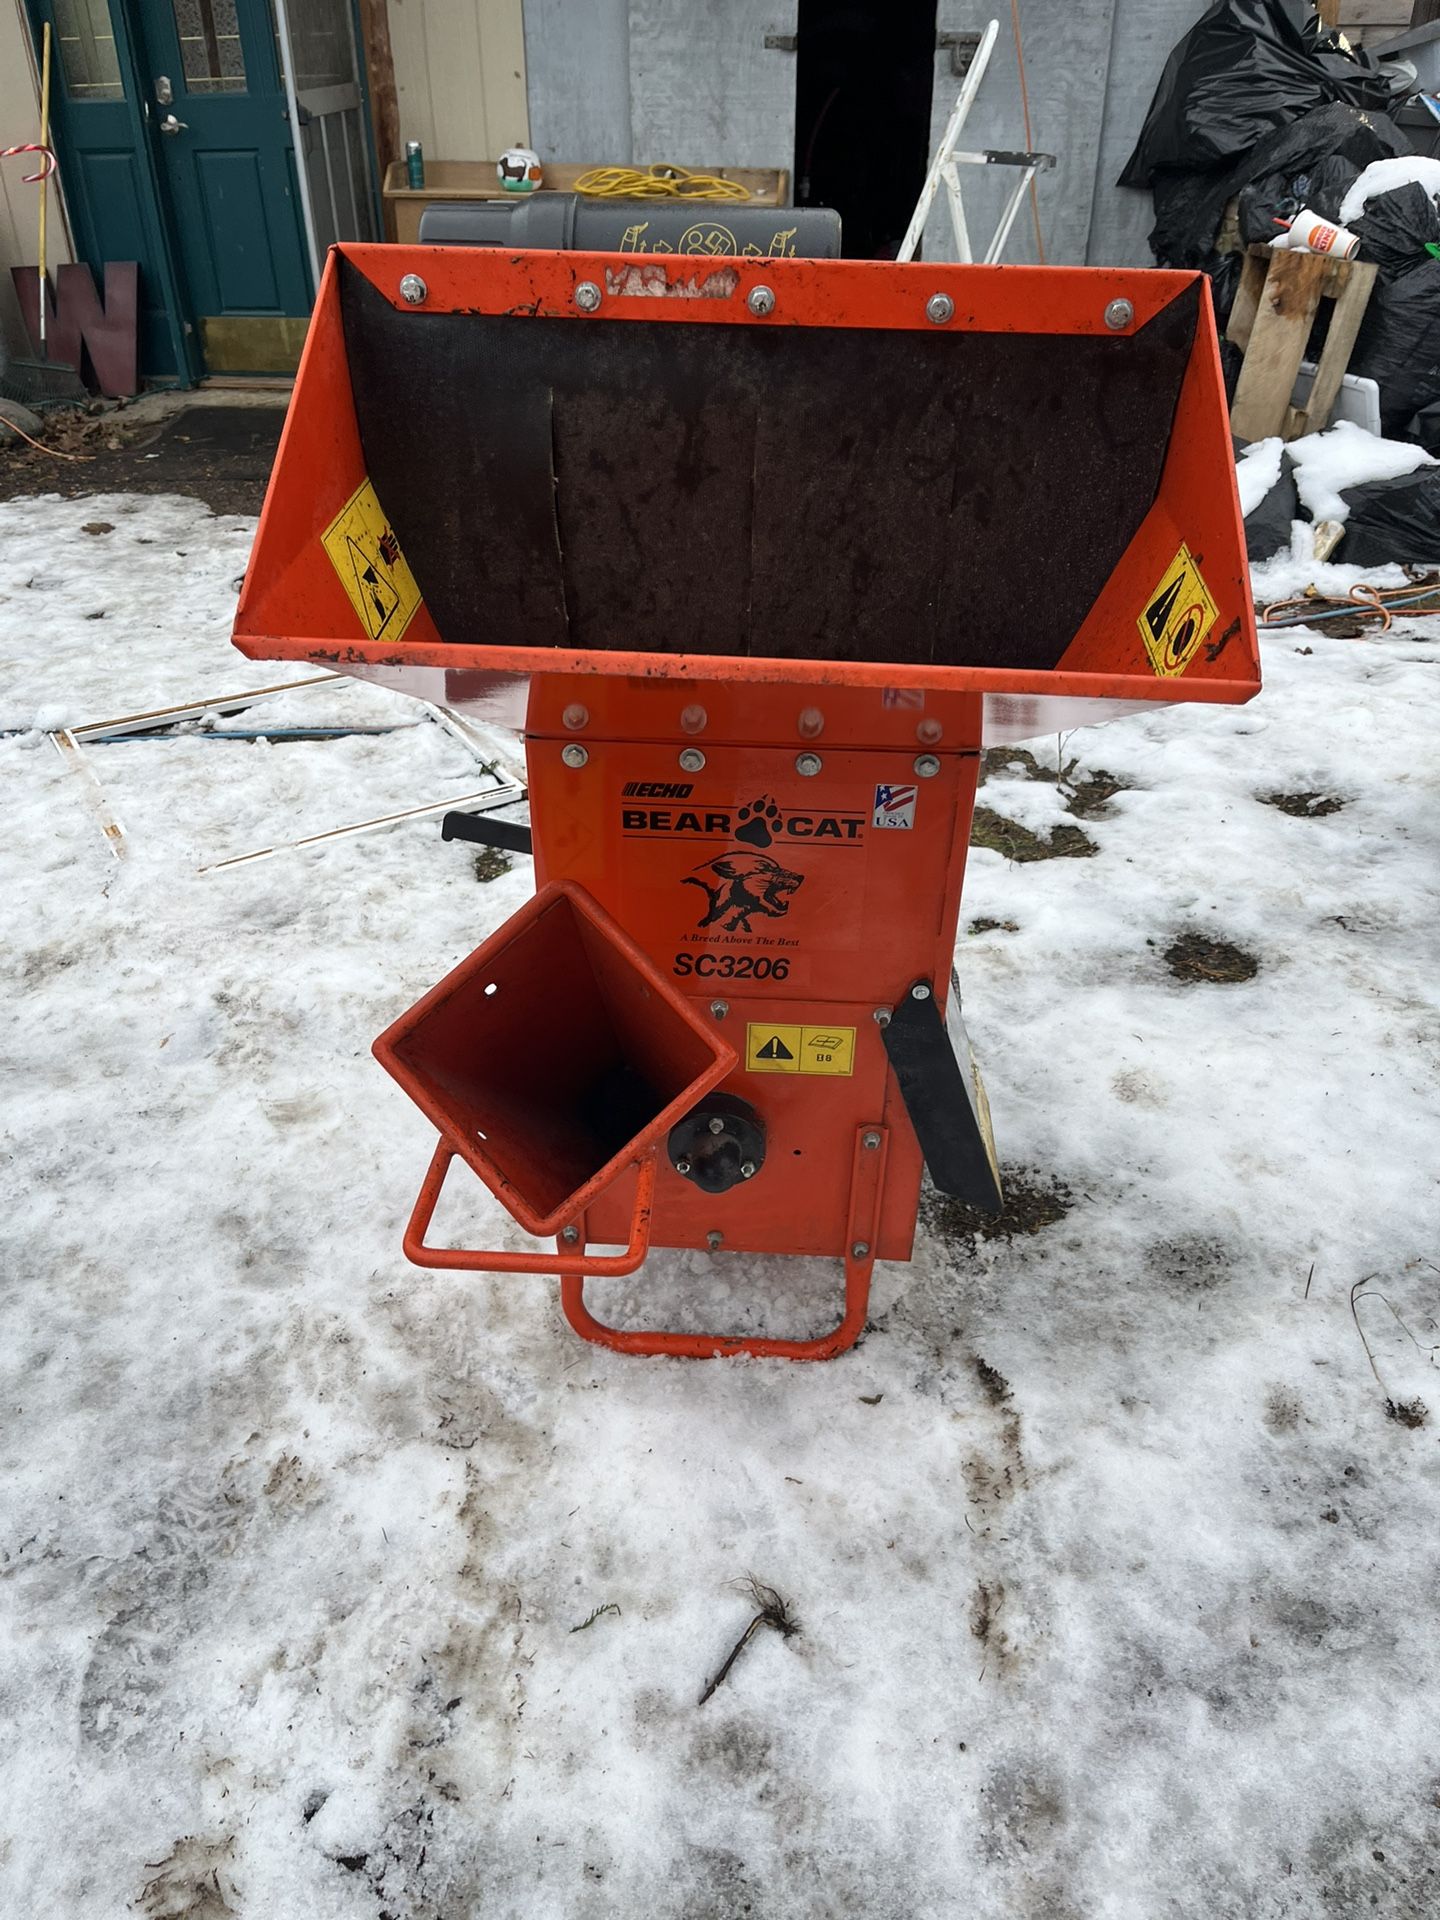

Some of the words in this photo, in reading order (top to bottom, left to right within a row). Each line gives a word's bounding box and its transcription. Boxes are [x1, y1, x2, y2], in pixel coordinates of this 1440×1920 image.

[635, 782, 695, 799] ECHO
[622, 810, 731, 833] BEAR
[786, 816, 865, 838] CAT
[876, 817, 909, 828] USA
[680, 933, 689, 941] A
[691, 933, 721, 943] Breed
[721, 935, 753, 945] Above
[755, 936, 775, 946] The
[777, 938, 800, 947] Best
[673, 952, 791, 980] SC3206
